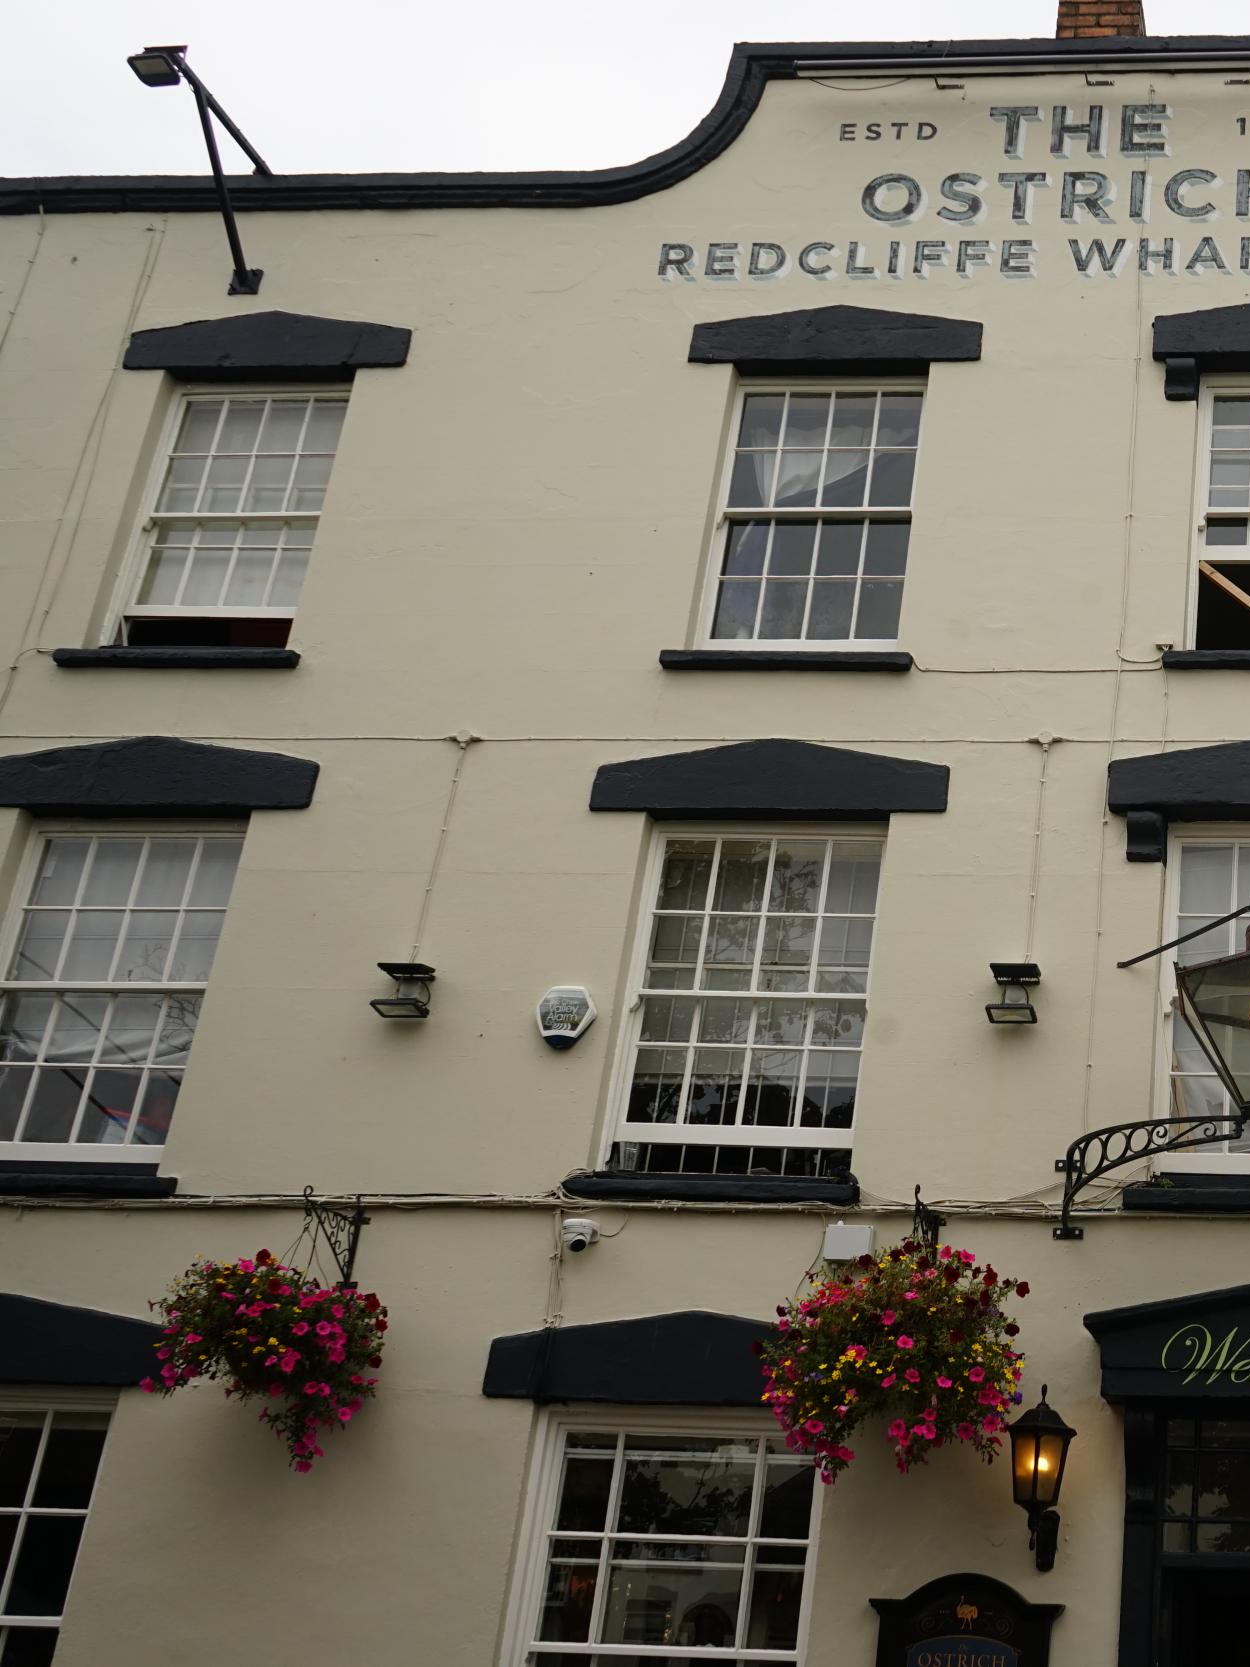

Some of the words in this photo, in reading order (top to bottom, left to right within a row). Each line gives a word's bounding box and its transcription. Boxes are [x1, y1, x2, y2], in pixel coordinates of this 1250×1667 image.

[839, 122, 938, 142] ESTD
[990, 103, 1173, 159] THE
[657, 239, 1040, 283] REDCLIFFE
[547, 1012, 578, 1022] Alarm
[549, 1003, 580, 1014] Valley
[918, 1652, 1006, 1667] OSTRICH
